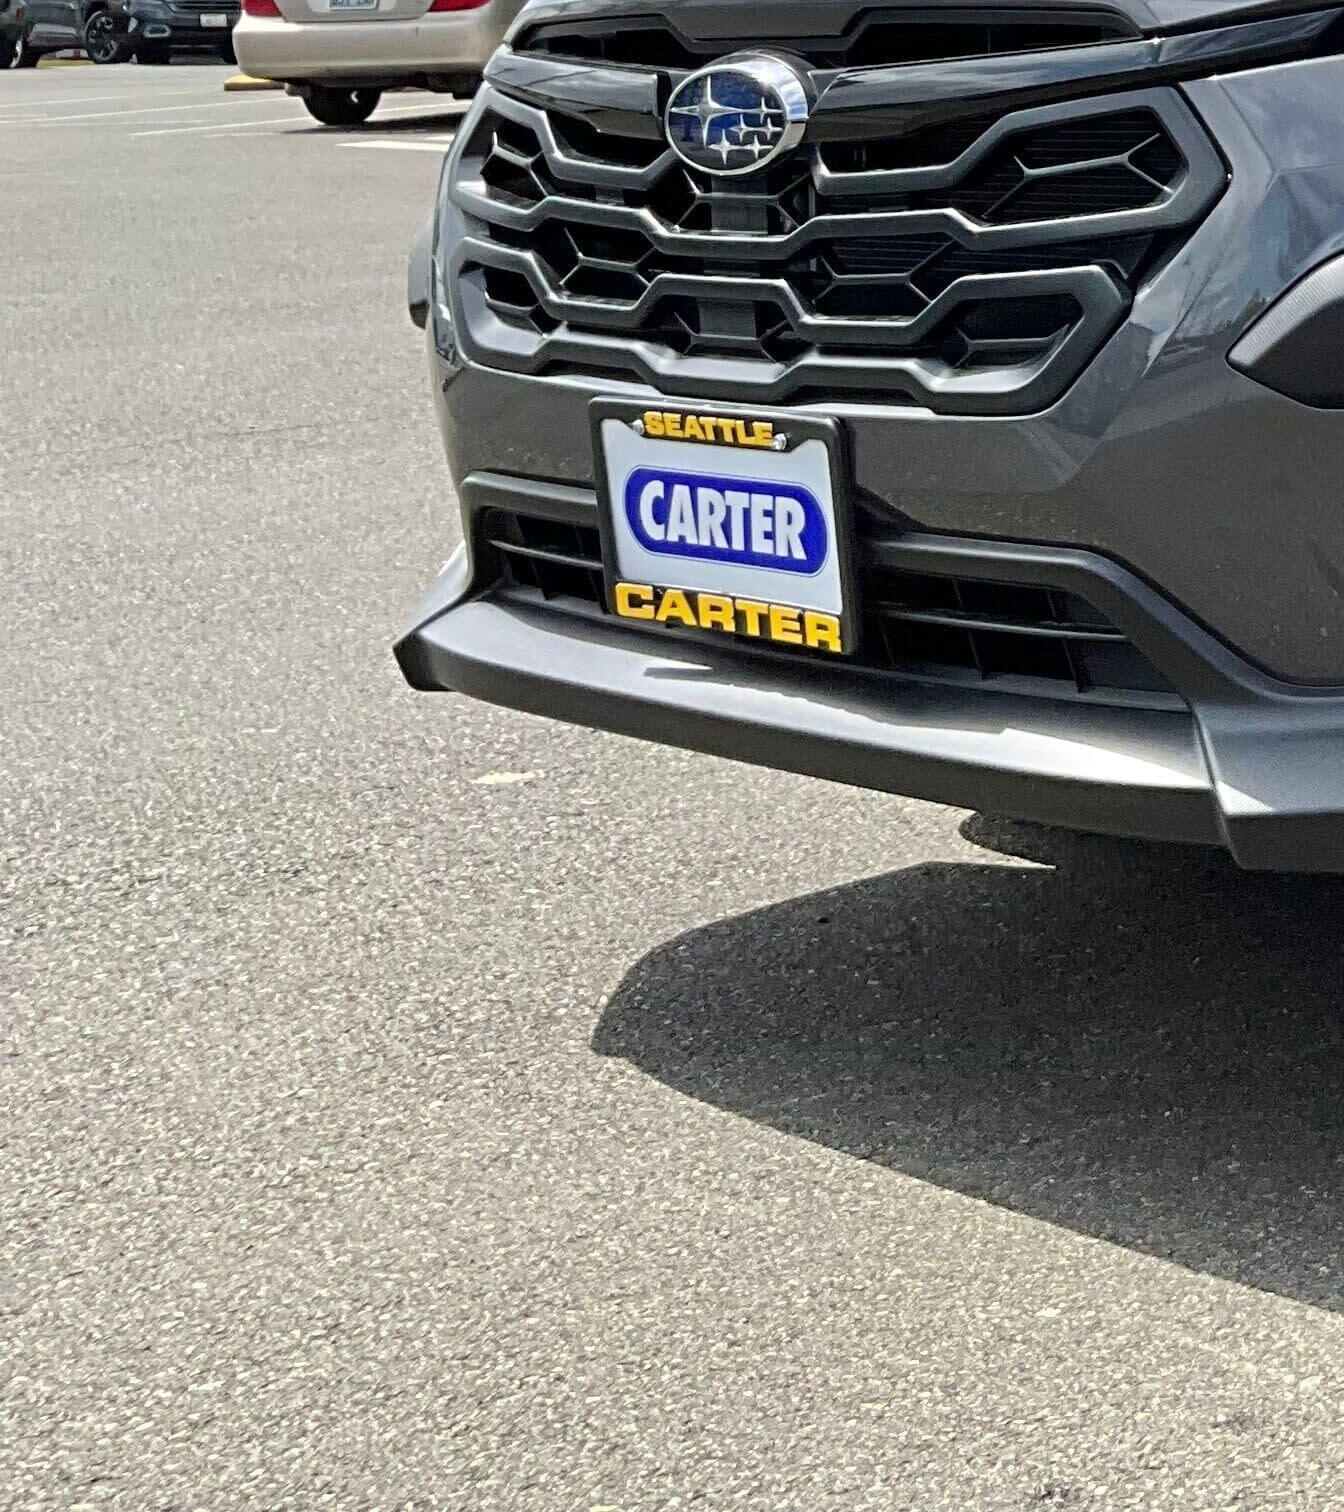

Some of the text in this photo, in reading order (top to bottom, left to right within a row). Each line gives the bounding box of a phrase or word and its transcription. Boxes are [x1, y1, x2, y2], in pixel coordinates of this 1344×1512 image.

[643, 410, 774, 448] SEATTLE
[639, 479, 808, 560] CARTER
[614, 581, 844, 653] CARTER
